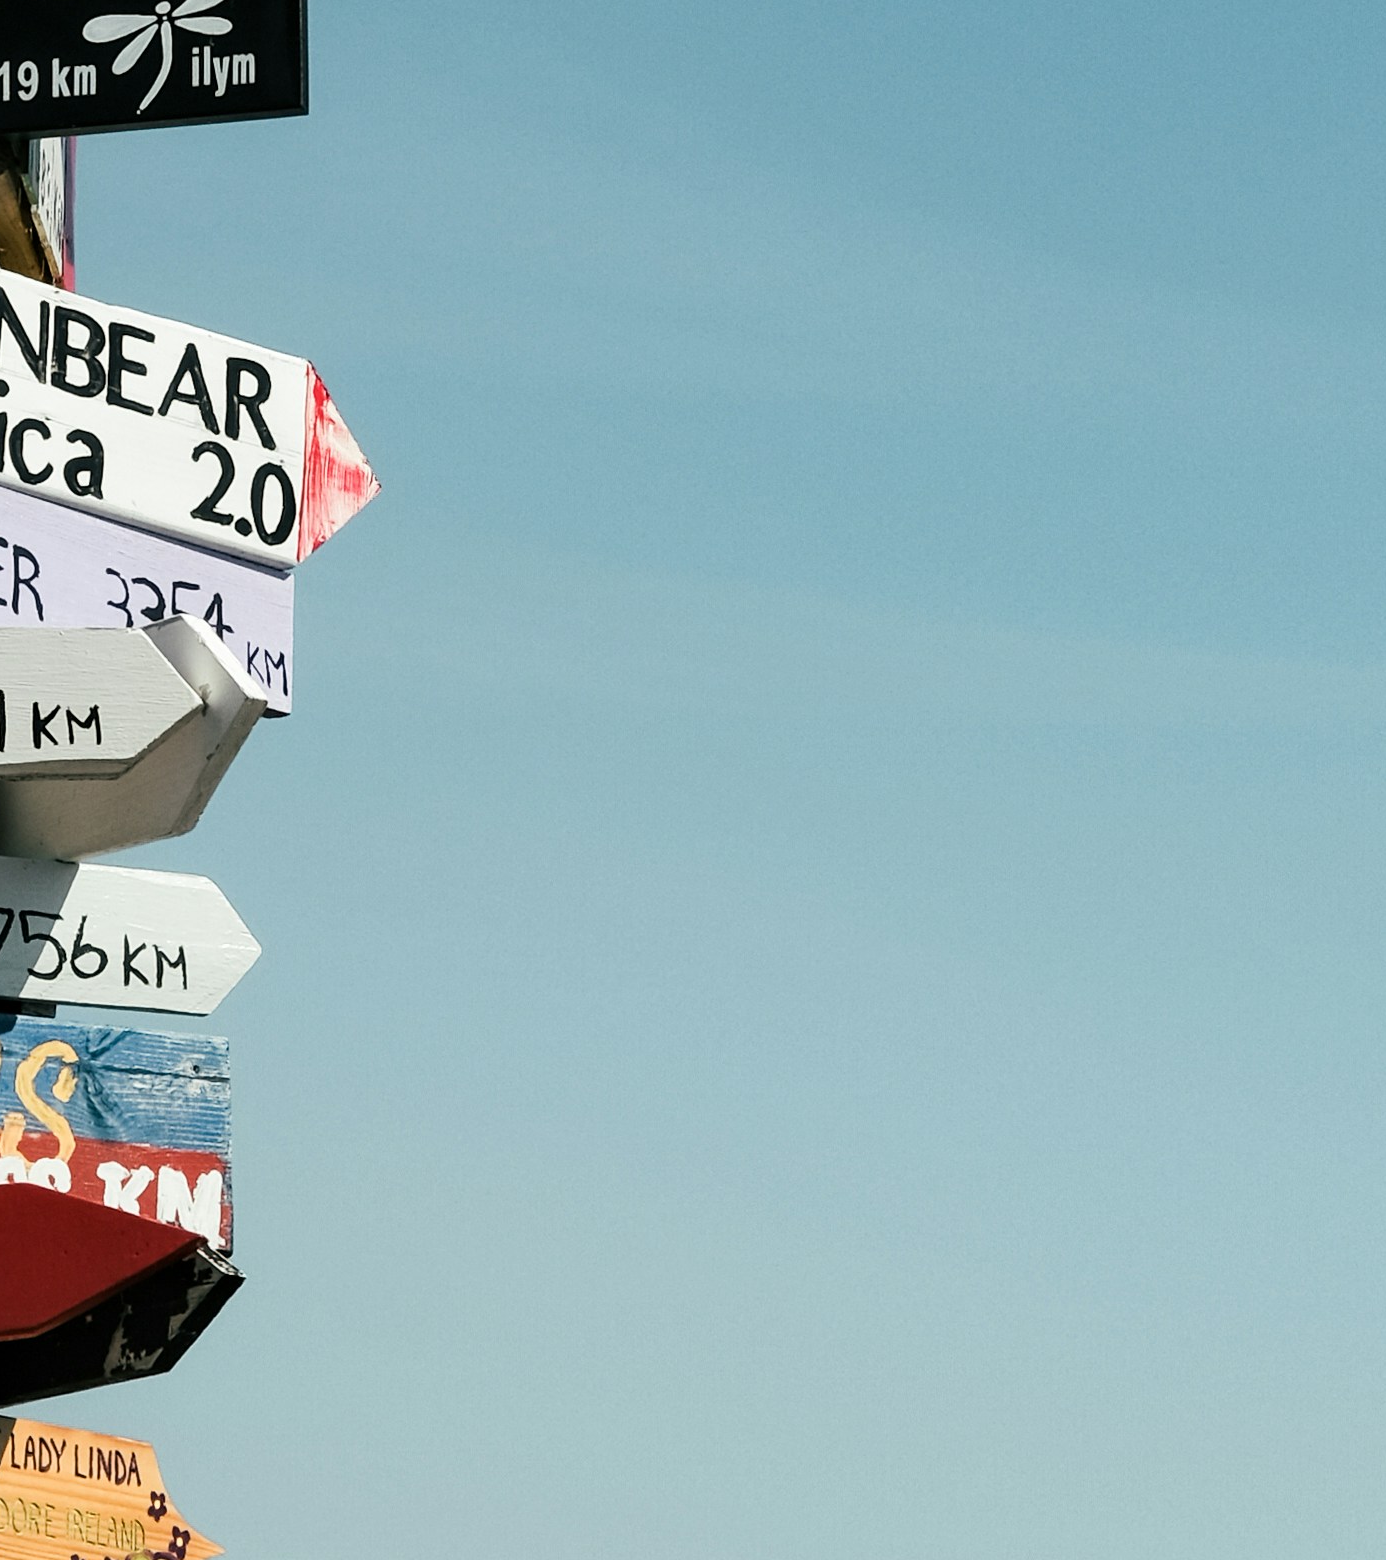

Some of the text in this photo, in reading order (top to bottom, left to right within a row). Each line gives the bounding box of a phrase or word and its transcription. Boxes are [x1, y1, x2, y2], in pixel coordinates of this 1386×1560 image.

[51, 57, 98, 99] km
[191, 45, 256, 97] ilym
[190, 441, 298, 548] 2.0
[247, 640, 289, 697] KM
[31, 699, 103, 748] KM
[121, 940, 189, 991] KM
[10, 1432, 67, 1474] LADY
[73, 1443, 142, 1487] LINDA
[66, 1506, 147, 1552] IRELAND
